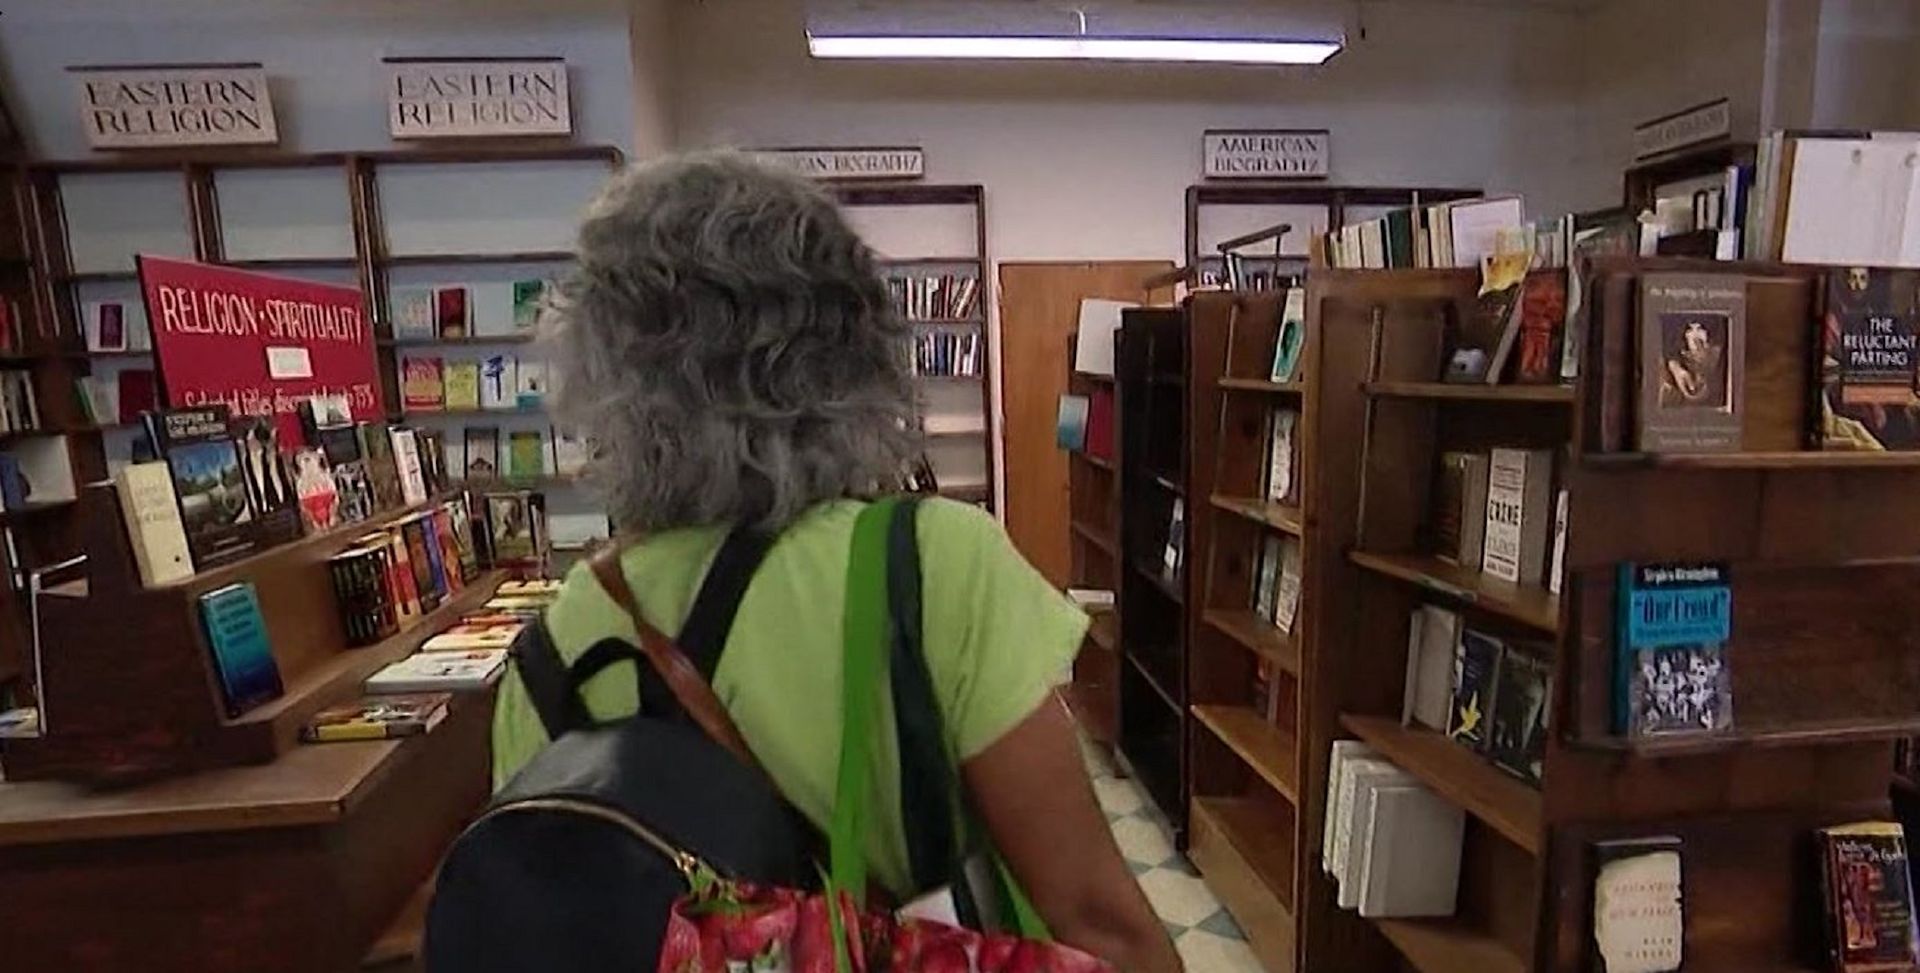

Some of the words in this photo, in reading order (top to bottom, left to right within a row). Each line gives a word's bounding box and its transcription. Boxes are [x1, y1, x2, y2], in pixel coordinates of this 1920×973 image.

[86, 79, 258, 105] EASTERN
[397, 71, 556, 98] EASTERN
[94, 107, 262, 135] RELIGION
[399, 101, 558, 127] RELIGION
[1218, 137, 1317, 152] AMERICAN
[1214, 157, 1319, 172] BIOGRAPHY
[158, 284, 258, 335] RELIGION
[265, 299, 362, 346] SPIRITUALITY
[1869, 317, 1893, 333] THE
[1843, 334, 1917, 350] RELUCTANT
[1850, 350, 1908, 366] PARTING
